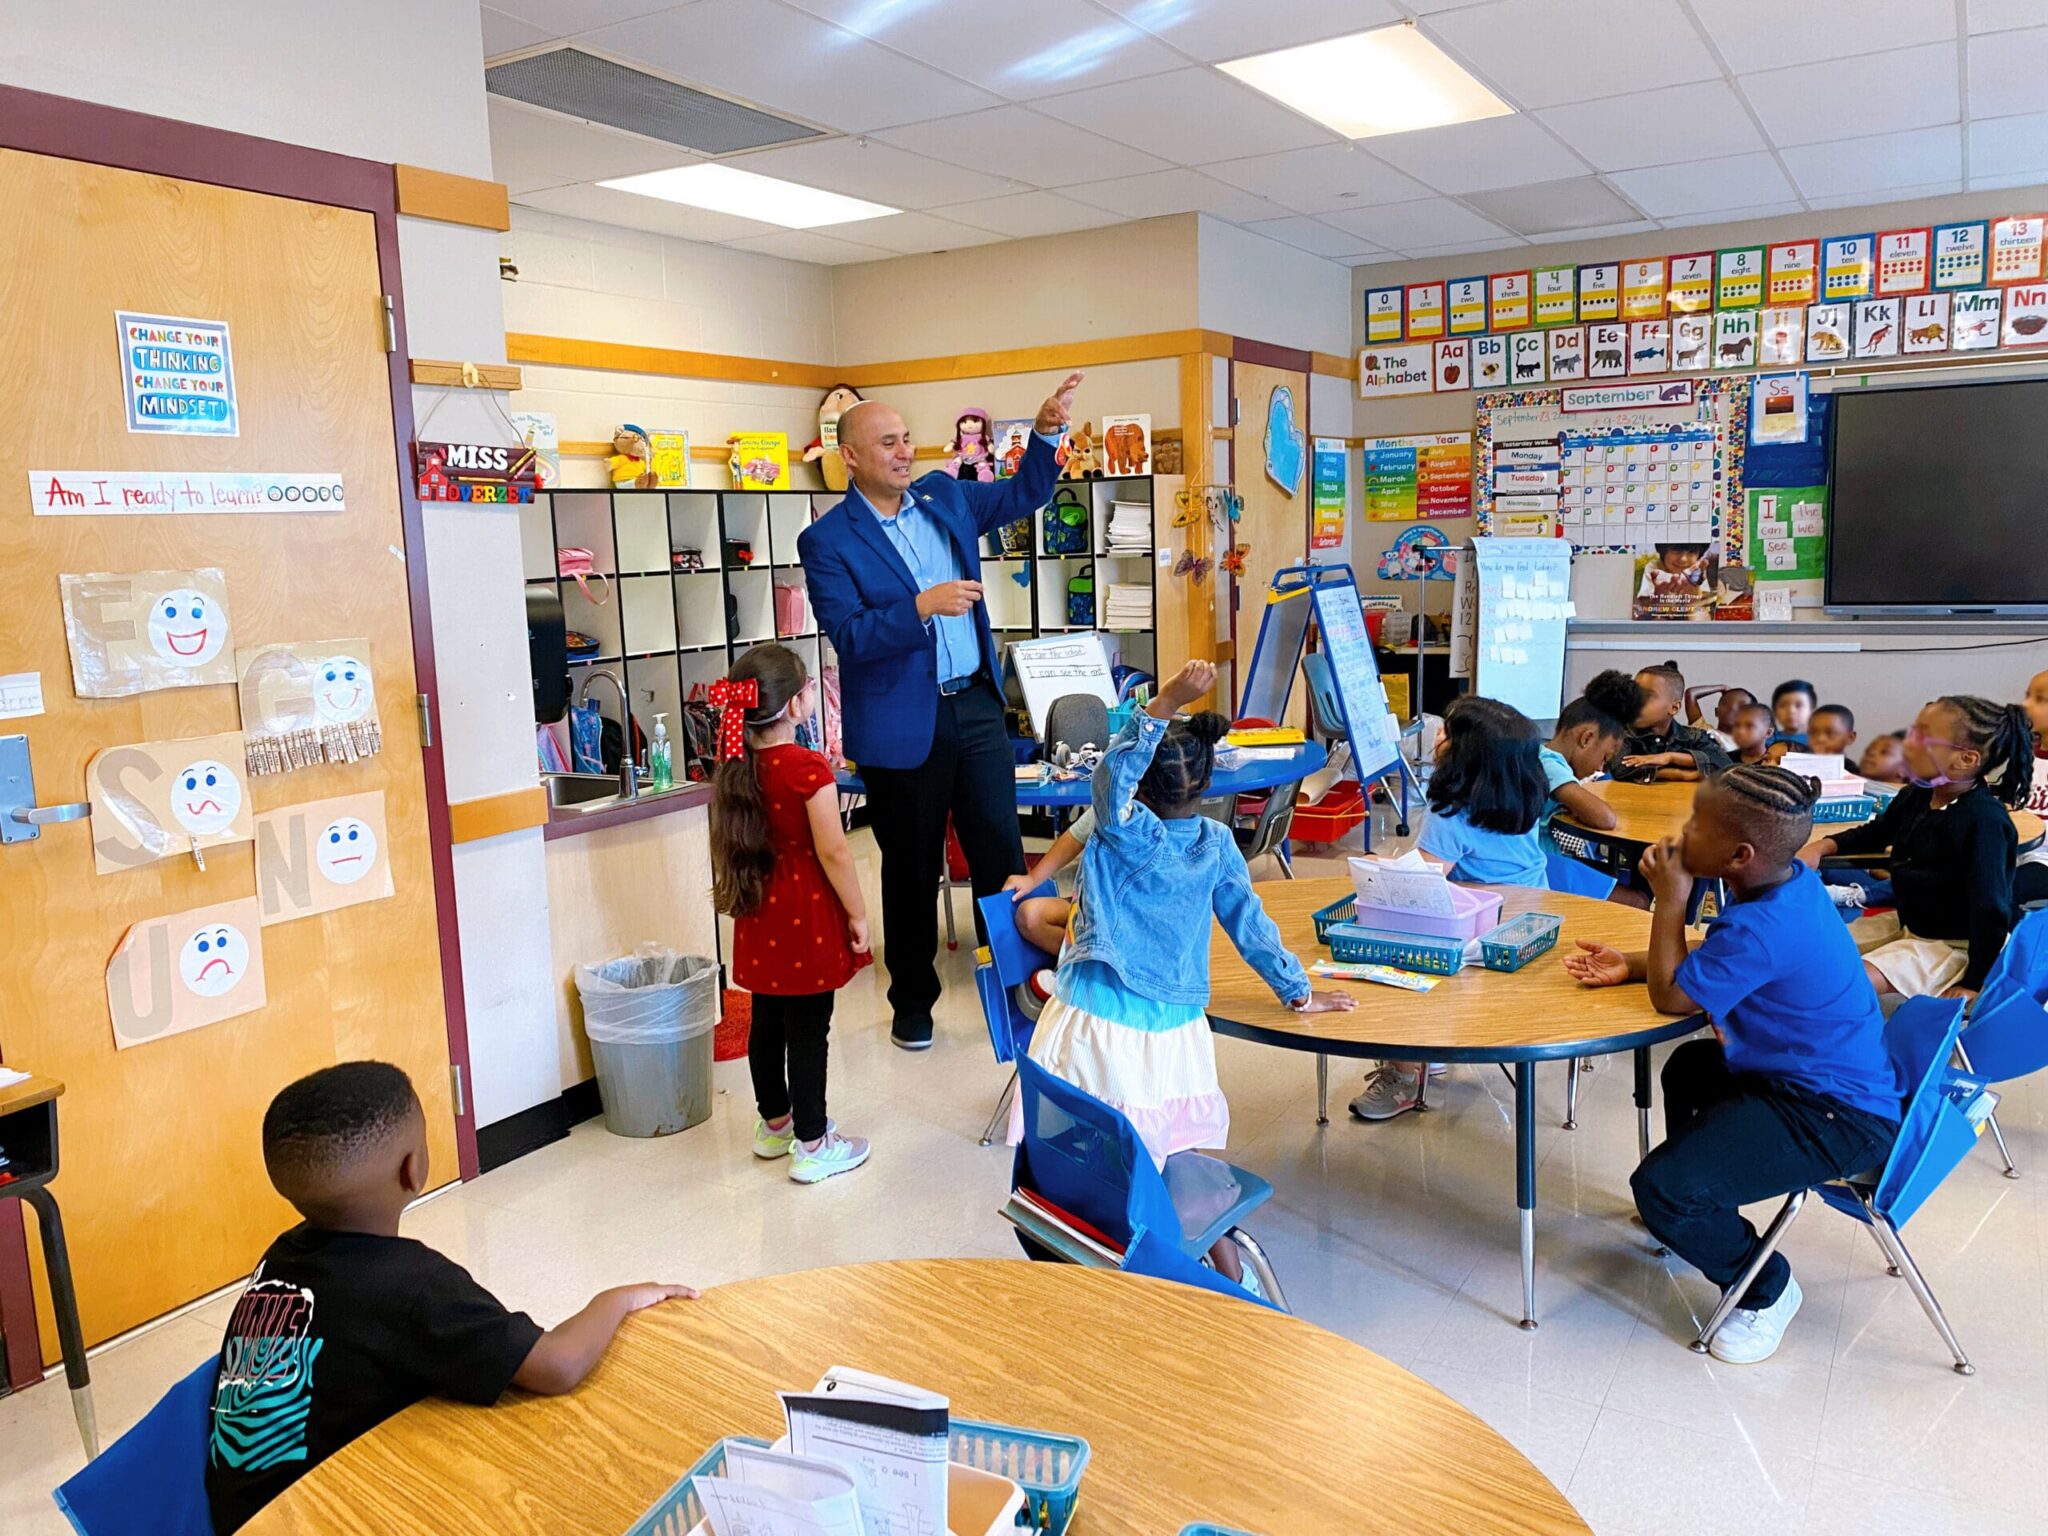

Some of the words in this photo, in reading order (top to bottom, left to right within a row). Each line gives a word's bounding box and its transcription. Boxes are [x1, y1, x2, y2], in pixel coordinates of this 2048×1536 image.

[2010, 223, 2028, 235] 13
[1896, 236, 1910, 249] 11
[1951, 230, 1968, 243] 12
[2000, 235, 2037, 246] thirteen
[1840, 242, 1857, 255] 10
[1945, 242, 1975, 252] twelve
[1787, 248, 1796, 261] 9
[1841, 255, 1855, 264] ten
[1889, 249, 1917, 258] eleven
[1688, 260, 1697, 272] 7
[1737, 254, 1746, 266] 8
[1783, 261, 1801, 269] nine
[1595, 269, 1603, 280] 5
[1639, 265, 1647, 277] 6
[1681, 271, 1702, 280] seven
[1731, 266, 1751, 275] eight
[1550, 272, 1559, 283] 4
[1463, 284, 1472, 295] 2
[1506, 279, 1515, 290] 3
[1547, 284, 1562, 292] four
[1592, 280, 1606, 289] five
[1381, 294, 1389, 304] 0
[1422, 289, 1429, 300] 1
[1460, 295, 1475, 303] two
[1501, 289, 1519, 298] three
[2014, 289, 2046, 306] Nn
[1377, 304, 1393, 312] zero
[1919, 300, 1936, 316] Ll
[1957, 295, 2000, 312] Mm
[1816, 308, 1839, 327] Jj
[1864, 305, 1891, 322] Kk
[1641, 324, 1660, 340] Ff
[1679, 322, 1704, 341] Gg
[1723, 318, 1750, 334] Hh
[130, 327, 182, 344] CHANGE
[186, 331, 219, 348] YOUR
[1555, 333, 1579, 349] Dd
[1598, 329, 1618, 343] Ee
[1440, 343, 1464, 358] Aa
[1478, 340, 1500, 355] Bb
[1516, 337, 1539, 352] Cc
[135, 347, 221, 373] THINKING
[1383, 356, 1407, 369] The
[135, 375, 188, 391] CHANGE
[190, 377, 224, 393] YOUR
[1365, 370, 1428, 386] Alphabet
[1769, 379, 1790, 396] Ss
[1567, 388, 1656, 406] September
[140, 395, 227, 418] MINDSET!
[1496, 410, 1539, 426] September
[1375, 438, 1414, 449] Months
[1435, 435, 1459, 445] Year
[447, 444, 508, 471] MISS
[1380, 451, 1413, 460] January
[1511, 452, 1543, 461] Monday
[1380, 463, 1416, 472] February
[1430, 460, 1457, 468] August
[1430, 472, 1470, 481] September
[1511, 474, 1544, 483] Tuesday
[45, 477, 85, 507] Am
[91, 480, 112, 506] I
[122, 482, 176, 512] ready
[180, 480, 205, 507] to
[211, 480, 263, 507] learn?
[447, 484, 531, 503] OVERZET
[1381, 487, 1400, 496] April
[1380, 500, 1397, 508] May
[1430, 496, 1468, 504] November
[1429, 508, 1467, 516] December
[1763, 499, 1774, 518] I
[1761, 526, 1781, 536] can
[1798, 524, 1815, 533] we
[1774, 556, 1784, 566] a
[96, 748, 165, 867] S
[258, 812, 313, 916] N
[109, 924, 175, 1040] U
